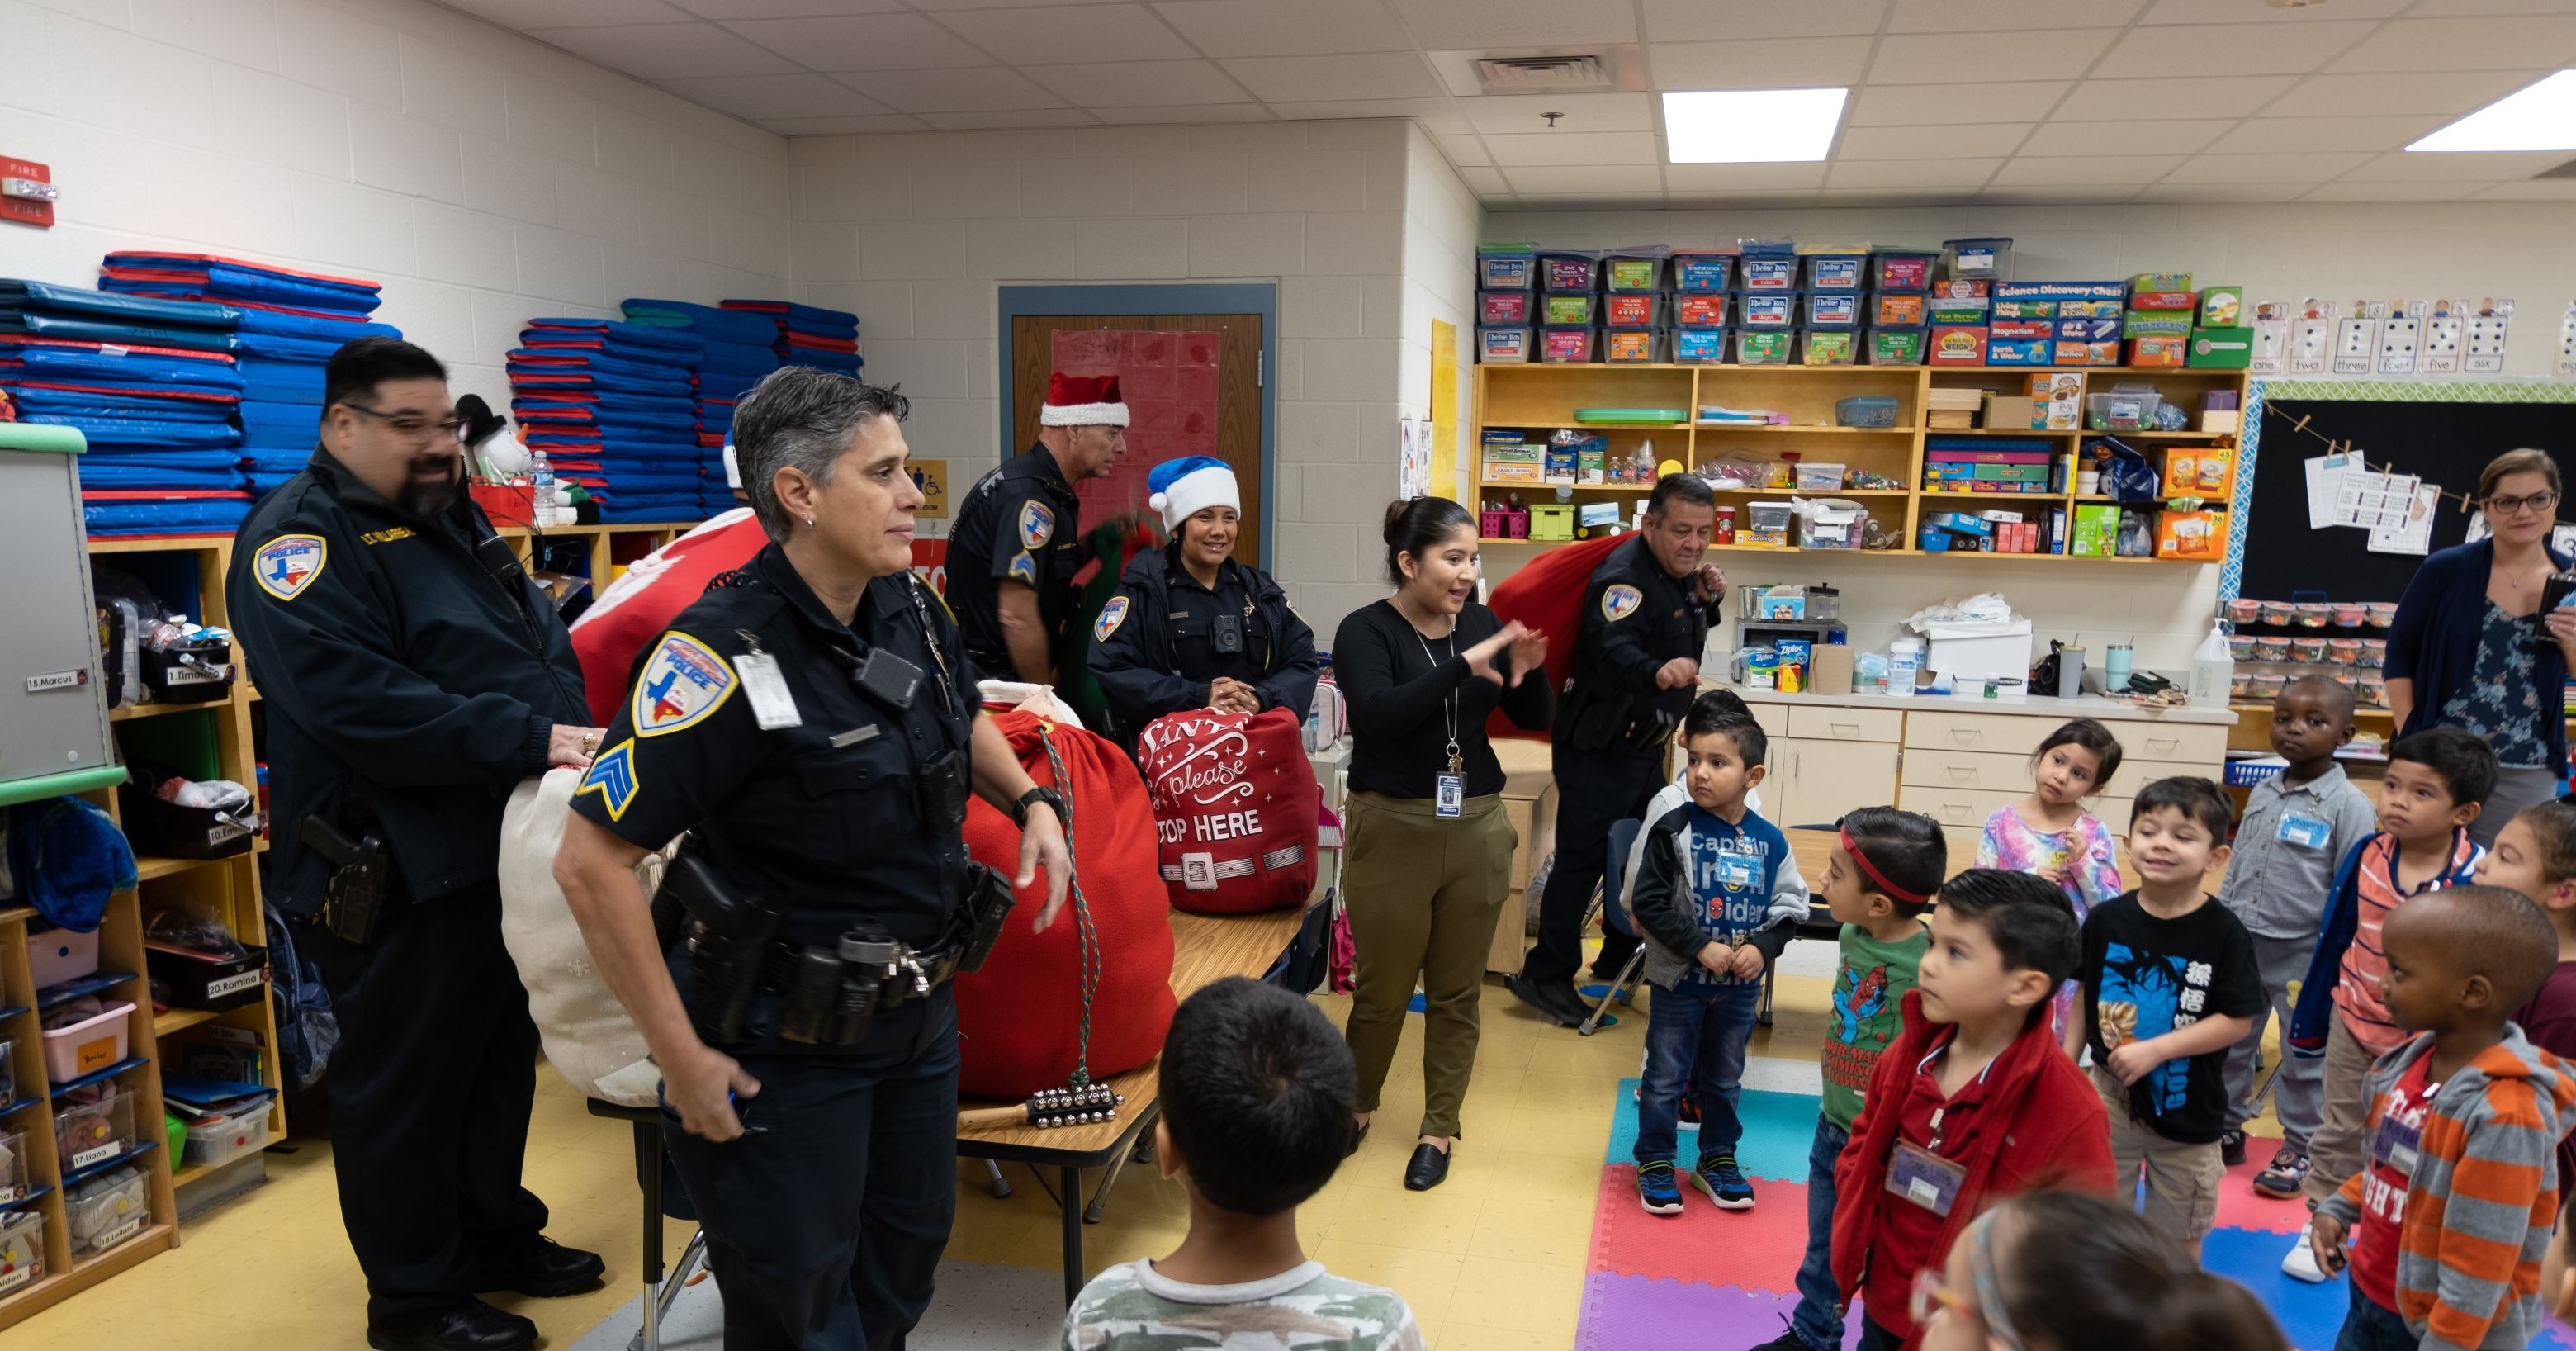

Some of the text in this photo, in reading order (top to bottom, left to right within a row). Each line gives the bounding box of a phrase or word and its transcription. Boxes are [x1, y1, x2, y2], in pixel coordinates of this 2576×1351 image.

[10, 164, 38, 178] FIRE
[14, 204, 43, 217] FIRE
[1998, 285, 2123, 297] Science Discovery Chest
[1996, 302, 2019, 310] Living
[2063, 301, 2082, 310] Light
[2069, 309, 2091, 317] Color
[1992, 328, 2035, 336] Magnetism
[2253, 361, 2274, 370] one
[2295, 360, 2318, 370] two
[2337, 359, 2367, 370] three
[2430, 358, 2450, 370] five
[2474, 359, 2491, 368] six
[268, 547, 310, 562] POLICE
[1781, 645, 1803, 655] Ziploc
[1756, 653, 1773, 661] Ziploc
[665, 652, 713, 690] POLICE
[28, 676, 72, 689] 15.Marcus
[1170, 759, 1248, 808] please
[1157, 809, 1263, 844] TOP HERE
[209, 975, 257, 995] 20.Romina
[74, 1149, 107, 1166] 17.Liana
[2365, 1173, 2408, 1224] GHT
